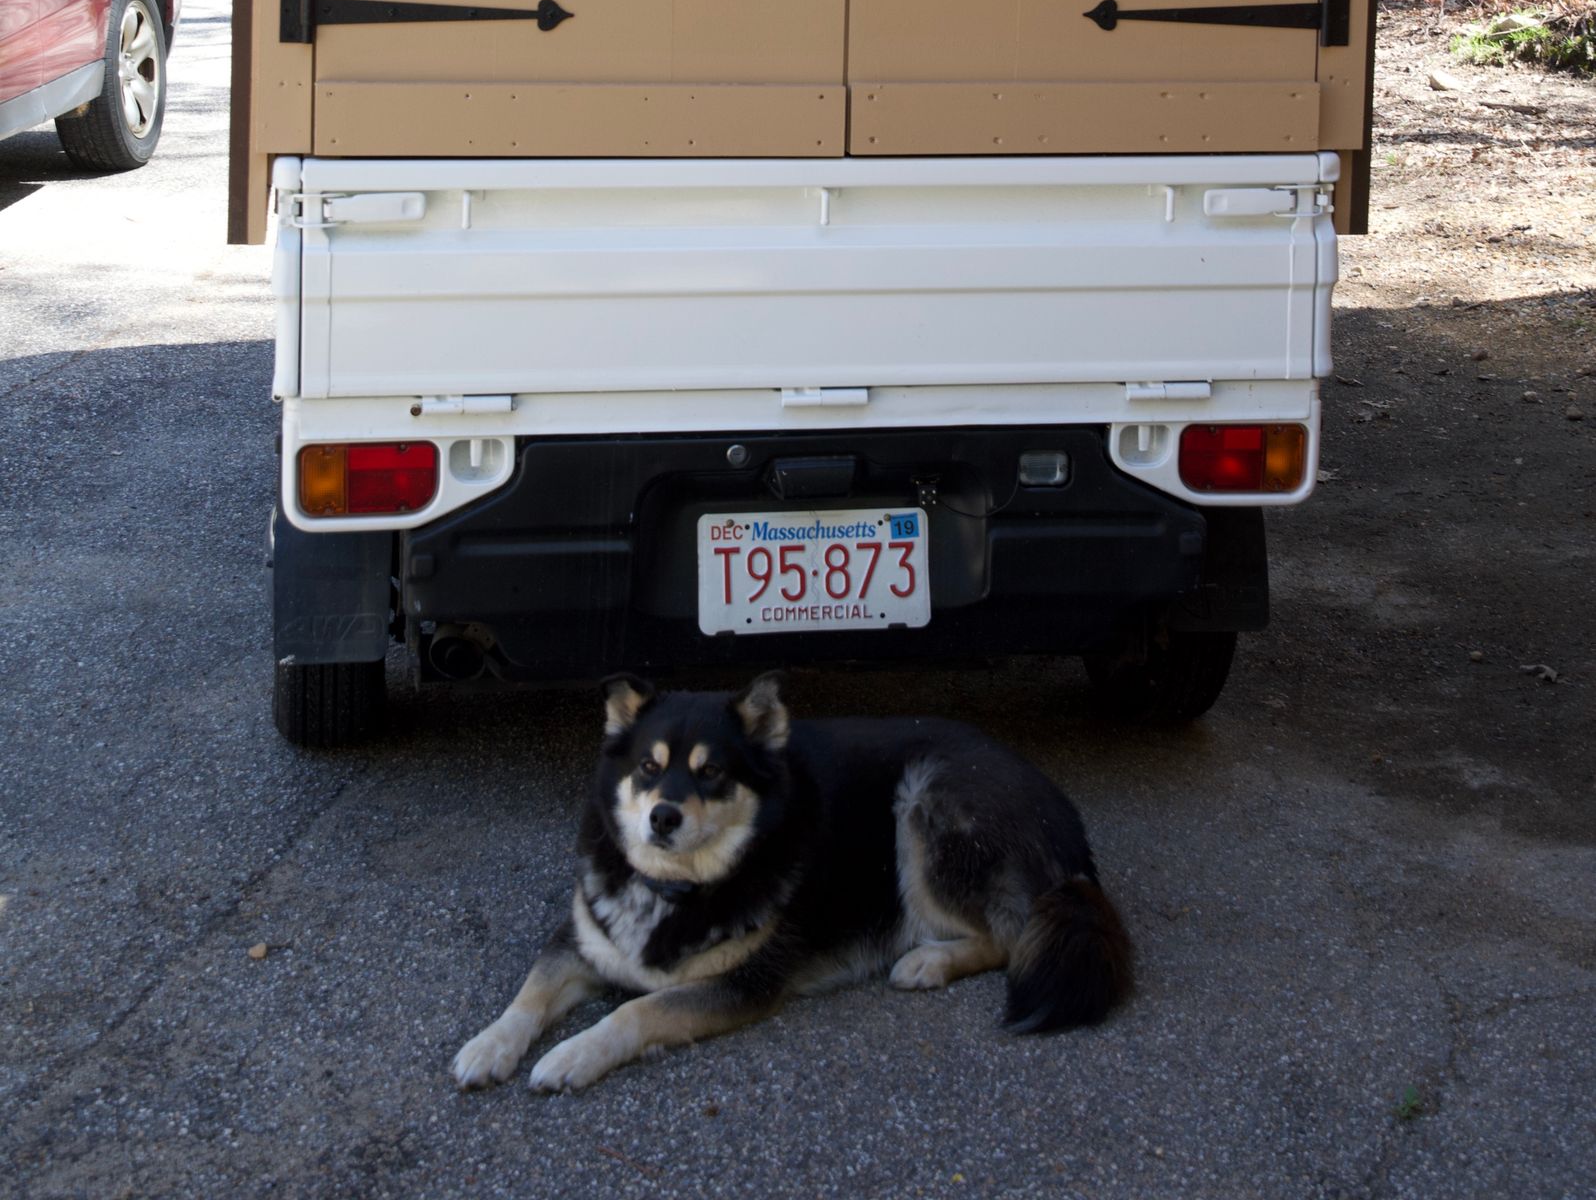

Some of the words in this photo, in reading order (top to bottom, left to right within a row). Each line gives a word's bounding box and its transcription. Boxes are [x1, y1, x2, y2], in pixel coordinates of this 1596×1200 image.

[711, 524, 744, 541] DEC
[751, 520, 877, 541] Massachusetts
[893, 519, 916, 536] 19
[761, 604, 874, 622] COMMERCIAL
